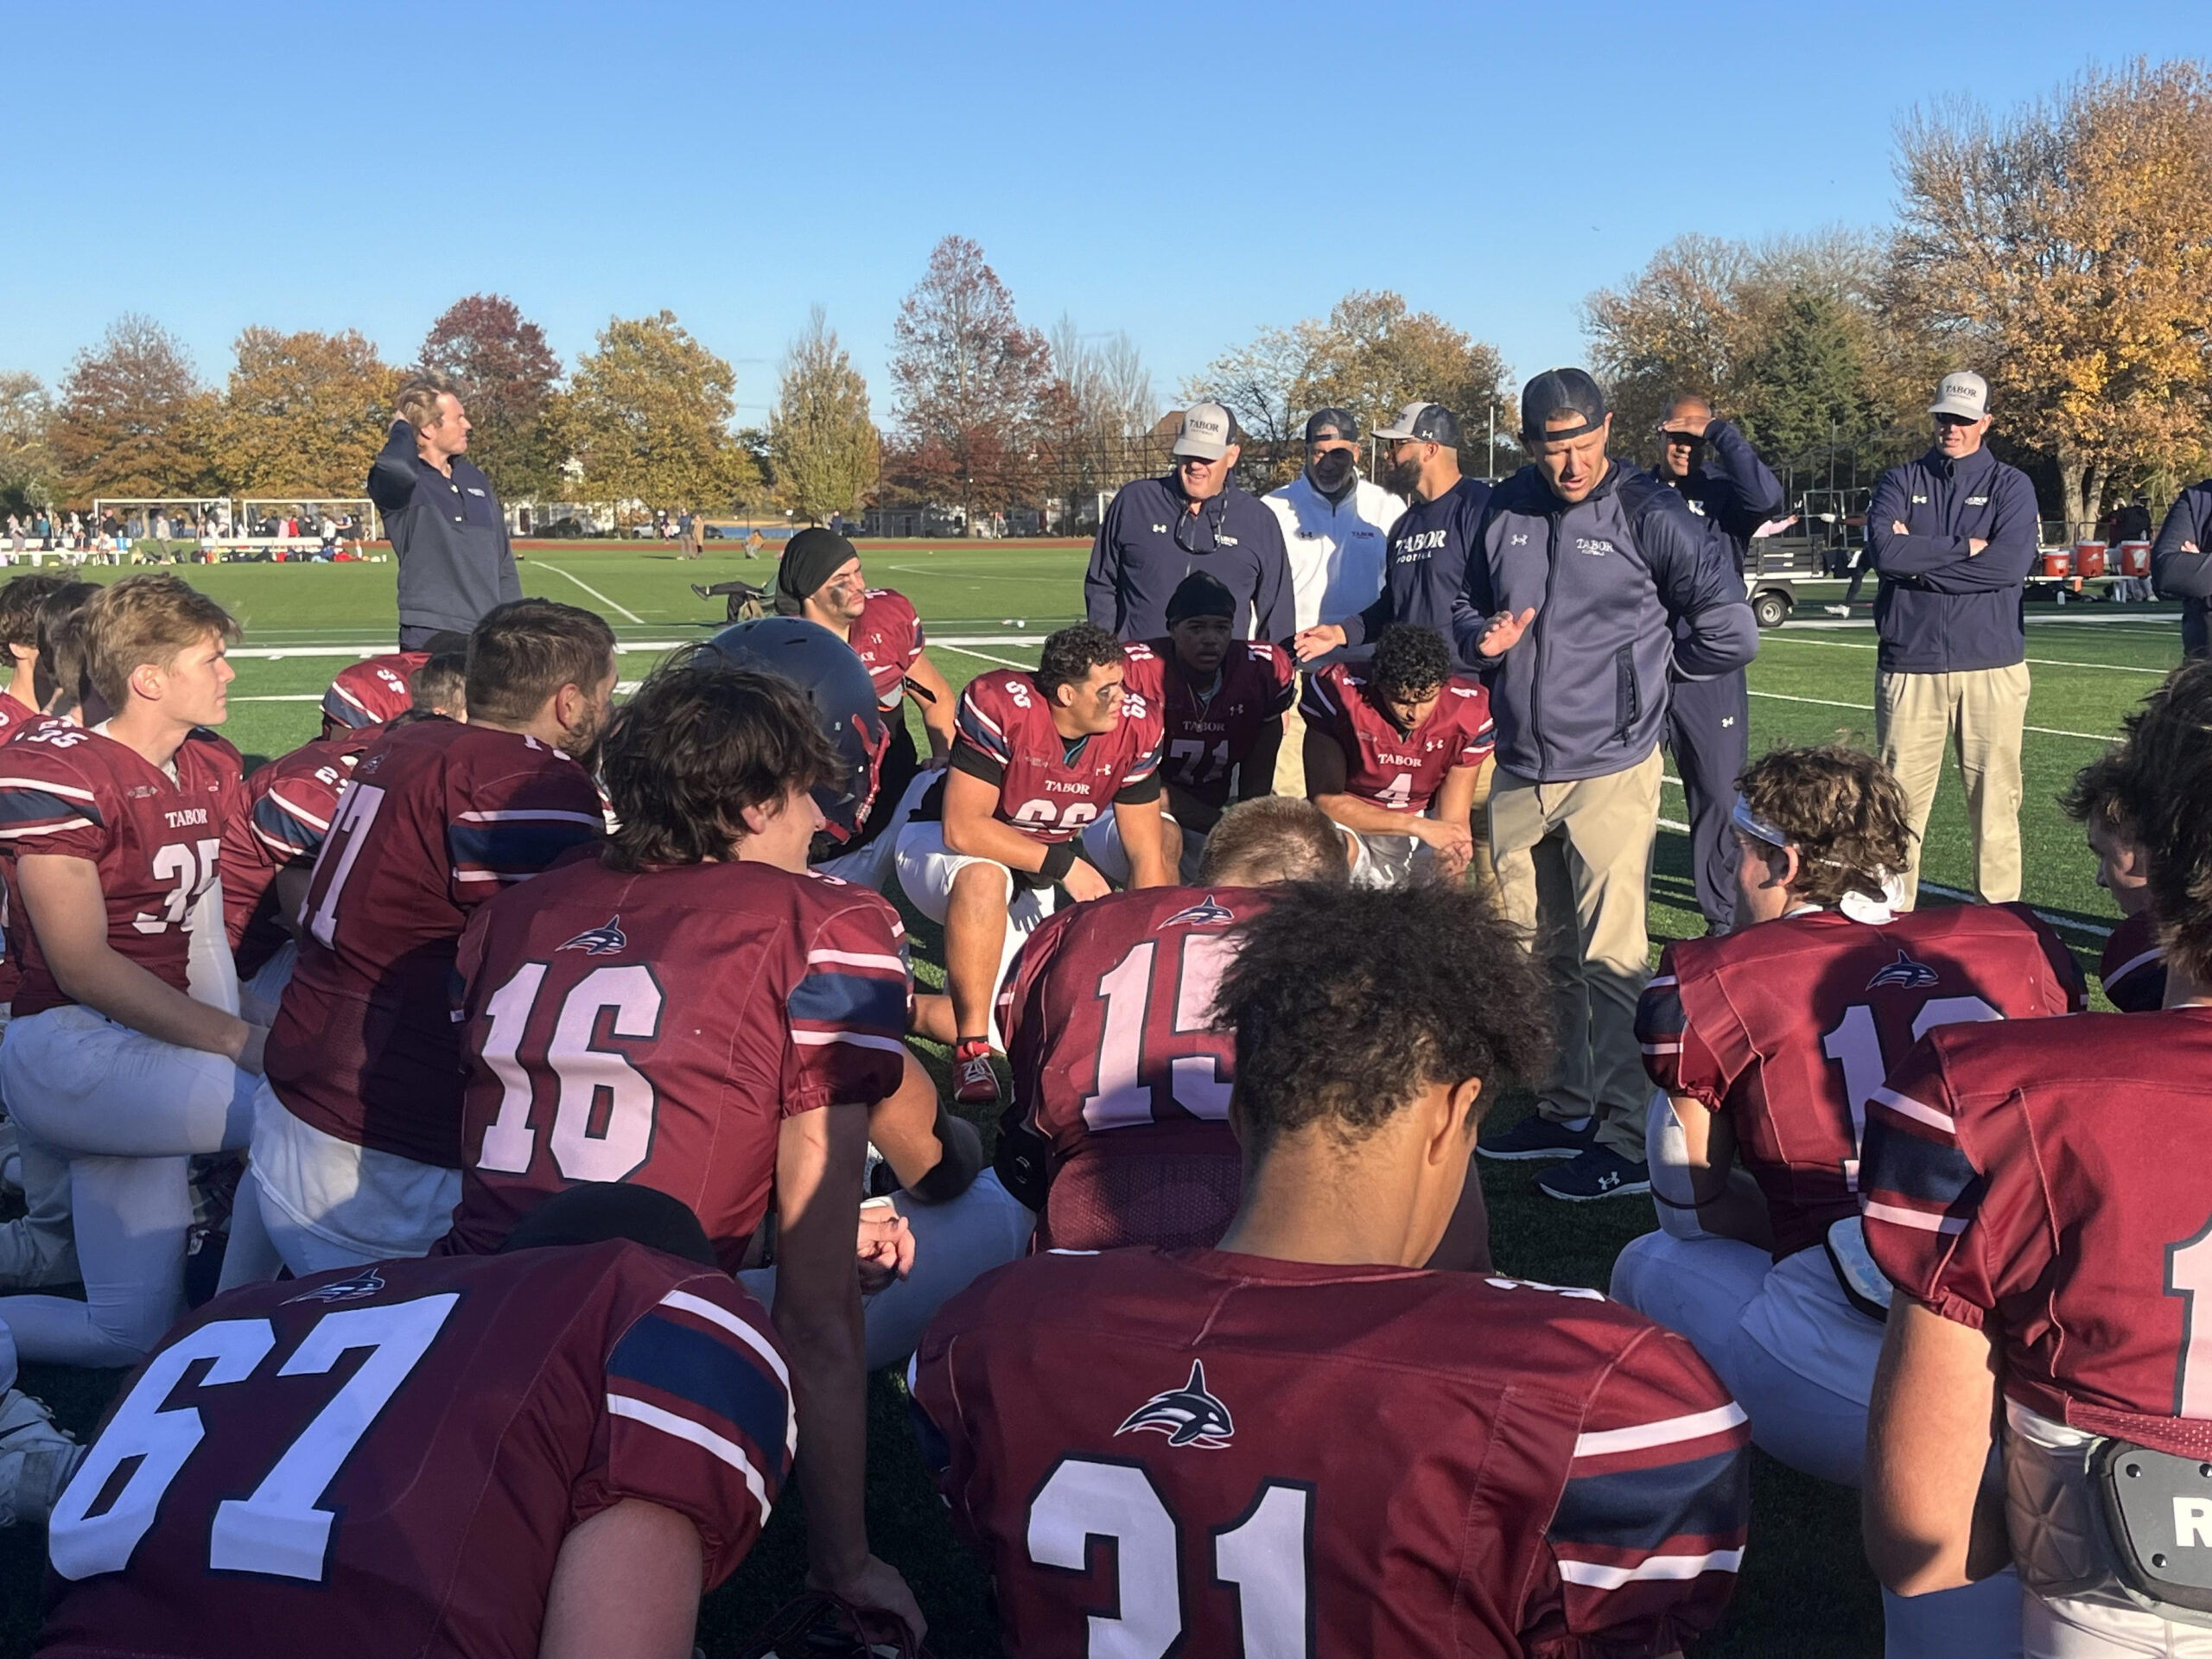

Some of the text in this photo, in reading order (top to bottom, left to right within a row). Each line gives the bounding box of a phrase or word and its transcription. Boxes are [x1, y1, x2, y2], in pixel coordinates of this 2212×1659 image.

[1945, 385, 1977, 397] TABOR
[1189, 419, 1219, 433] TABOR
[1395, 530, 1446, 556] TABOR
[1575, 537, 1614, 552] TABOR
[1182, 721, 1225, 733] TABOR
[1169, 738, 1230, 785] 71
[1378, 753, 1422, 767] TABOR
[1045, 779, 1090, 795] TABOR
[1374, 772, 1414, 809] 4
[164, 809, 207, 828] TABOR
[475, 962, 663, 1184] 16
[48, 1292, 462, 1582] 67
